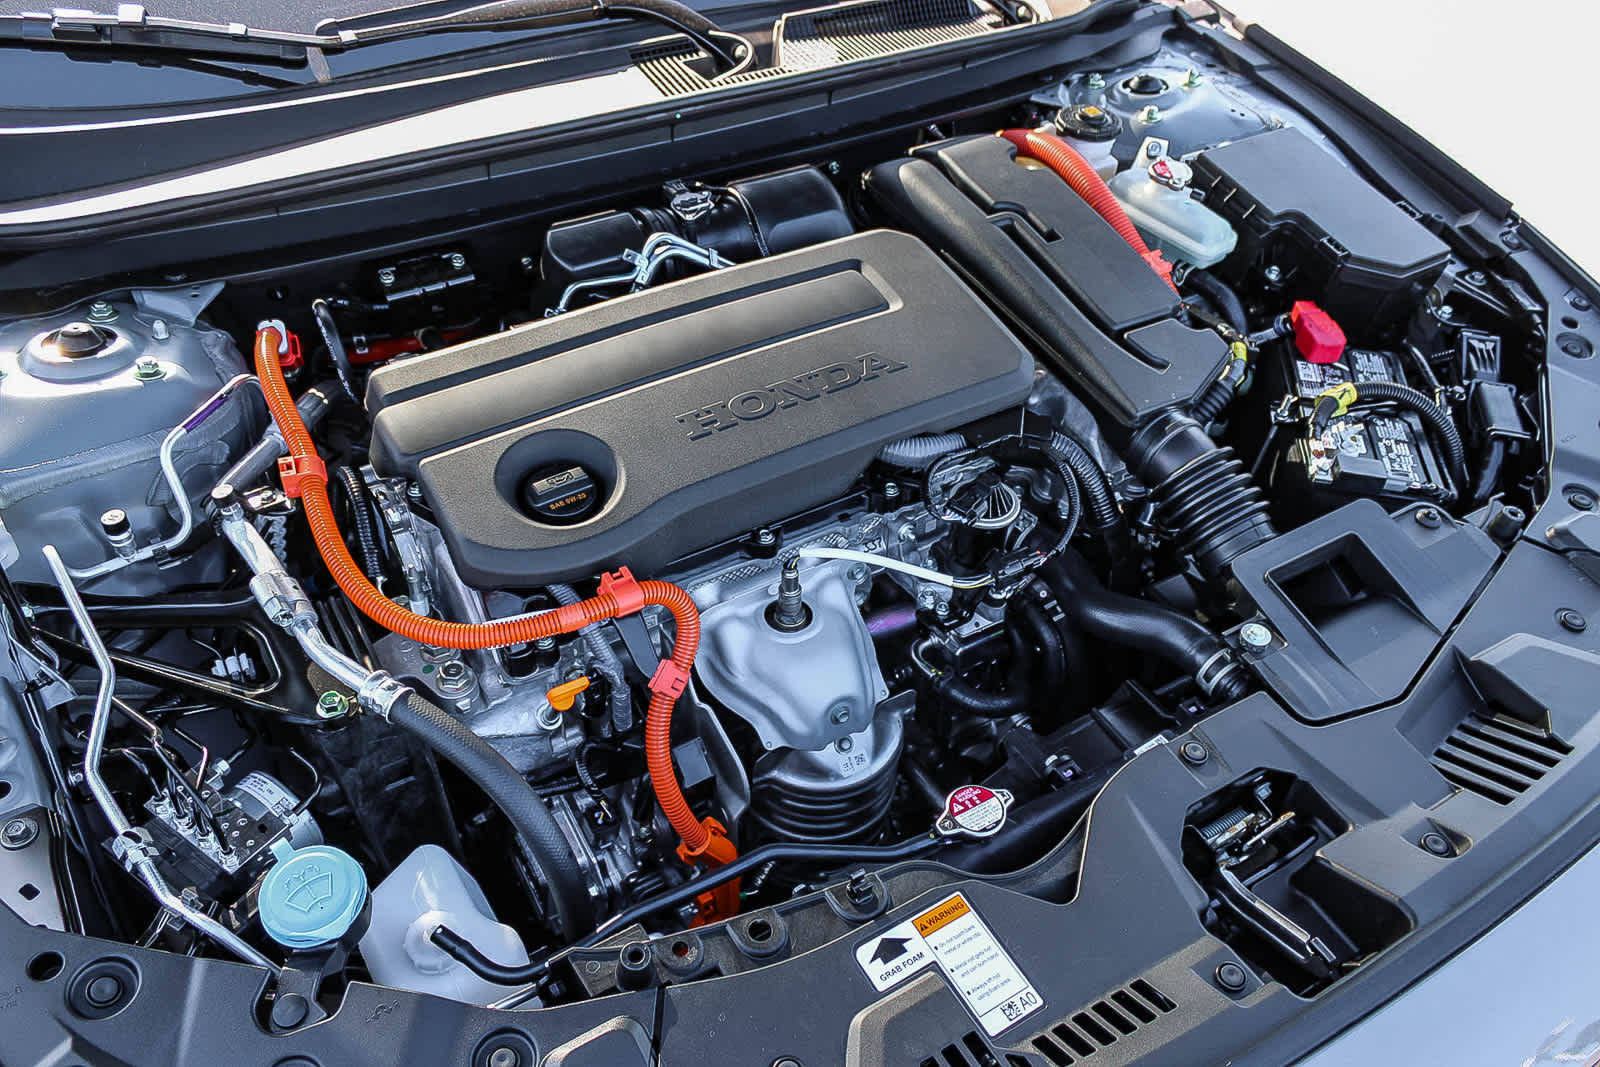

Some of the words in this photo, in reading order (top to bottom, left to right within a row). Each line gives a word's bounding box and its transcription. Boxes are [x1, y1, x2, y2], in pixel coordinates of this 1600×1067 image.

[675, 352, 908, 441] HONDA
[926, 901, 965, 925] WARNING
[880, 965, 903, 981] GRAB
[902, 951, 925, 969] FOAM
